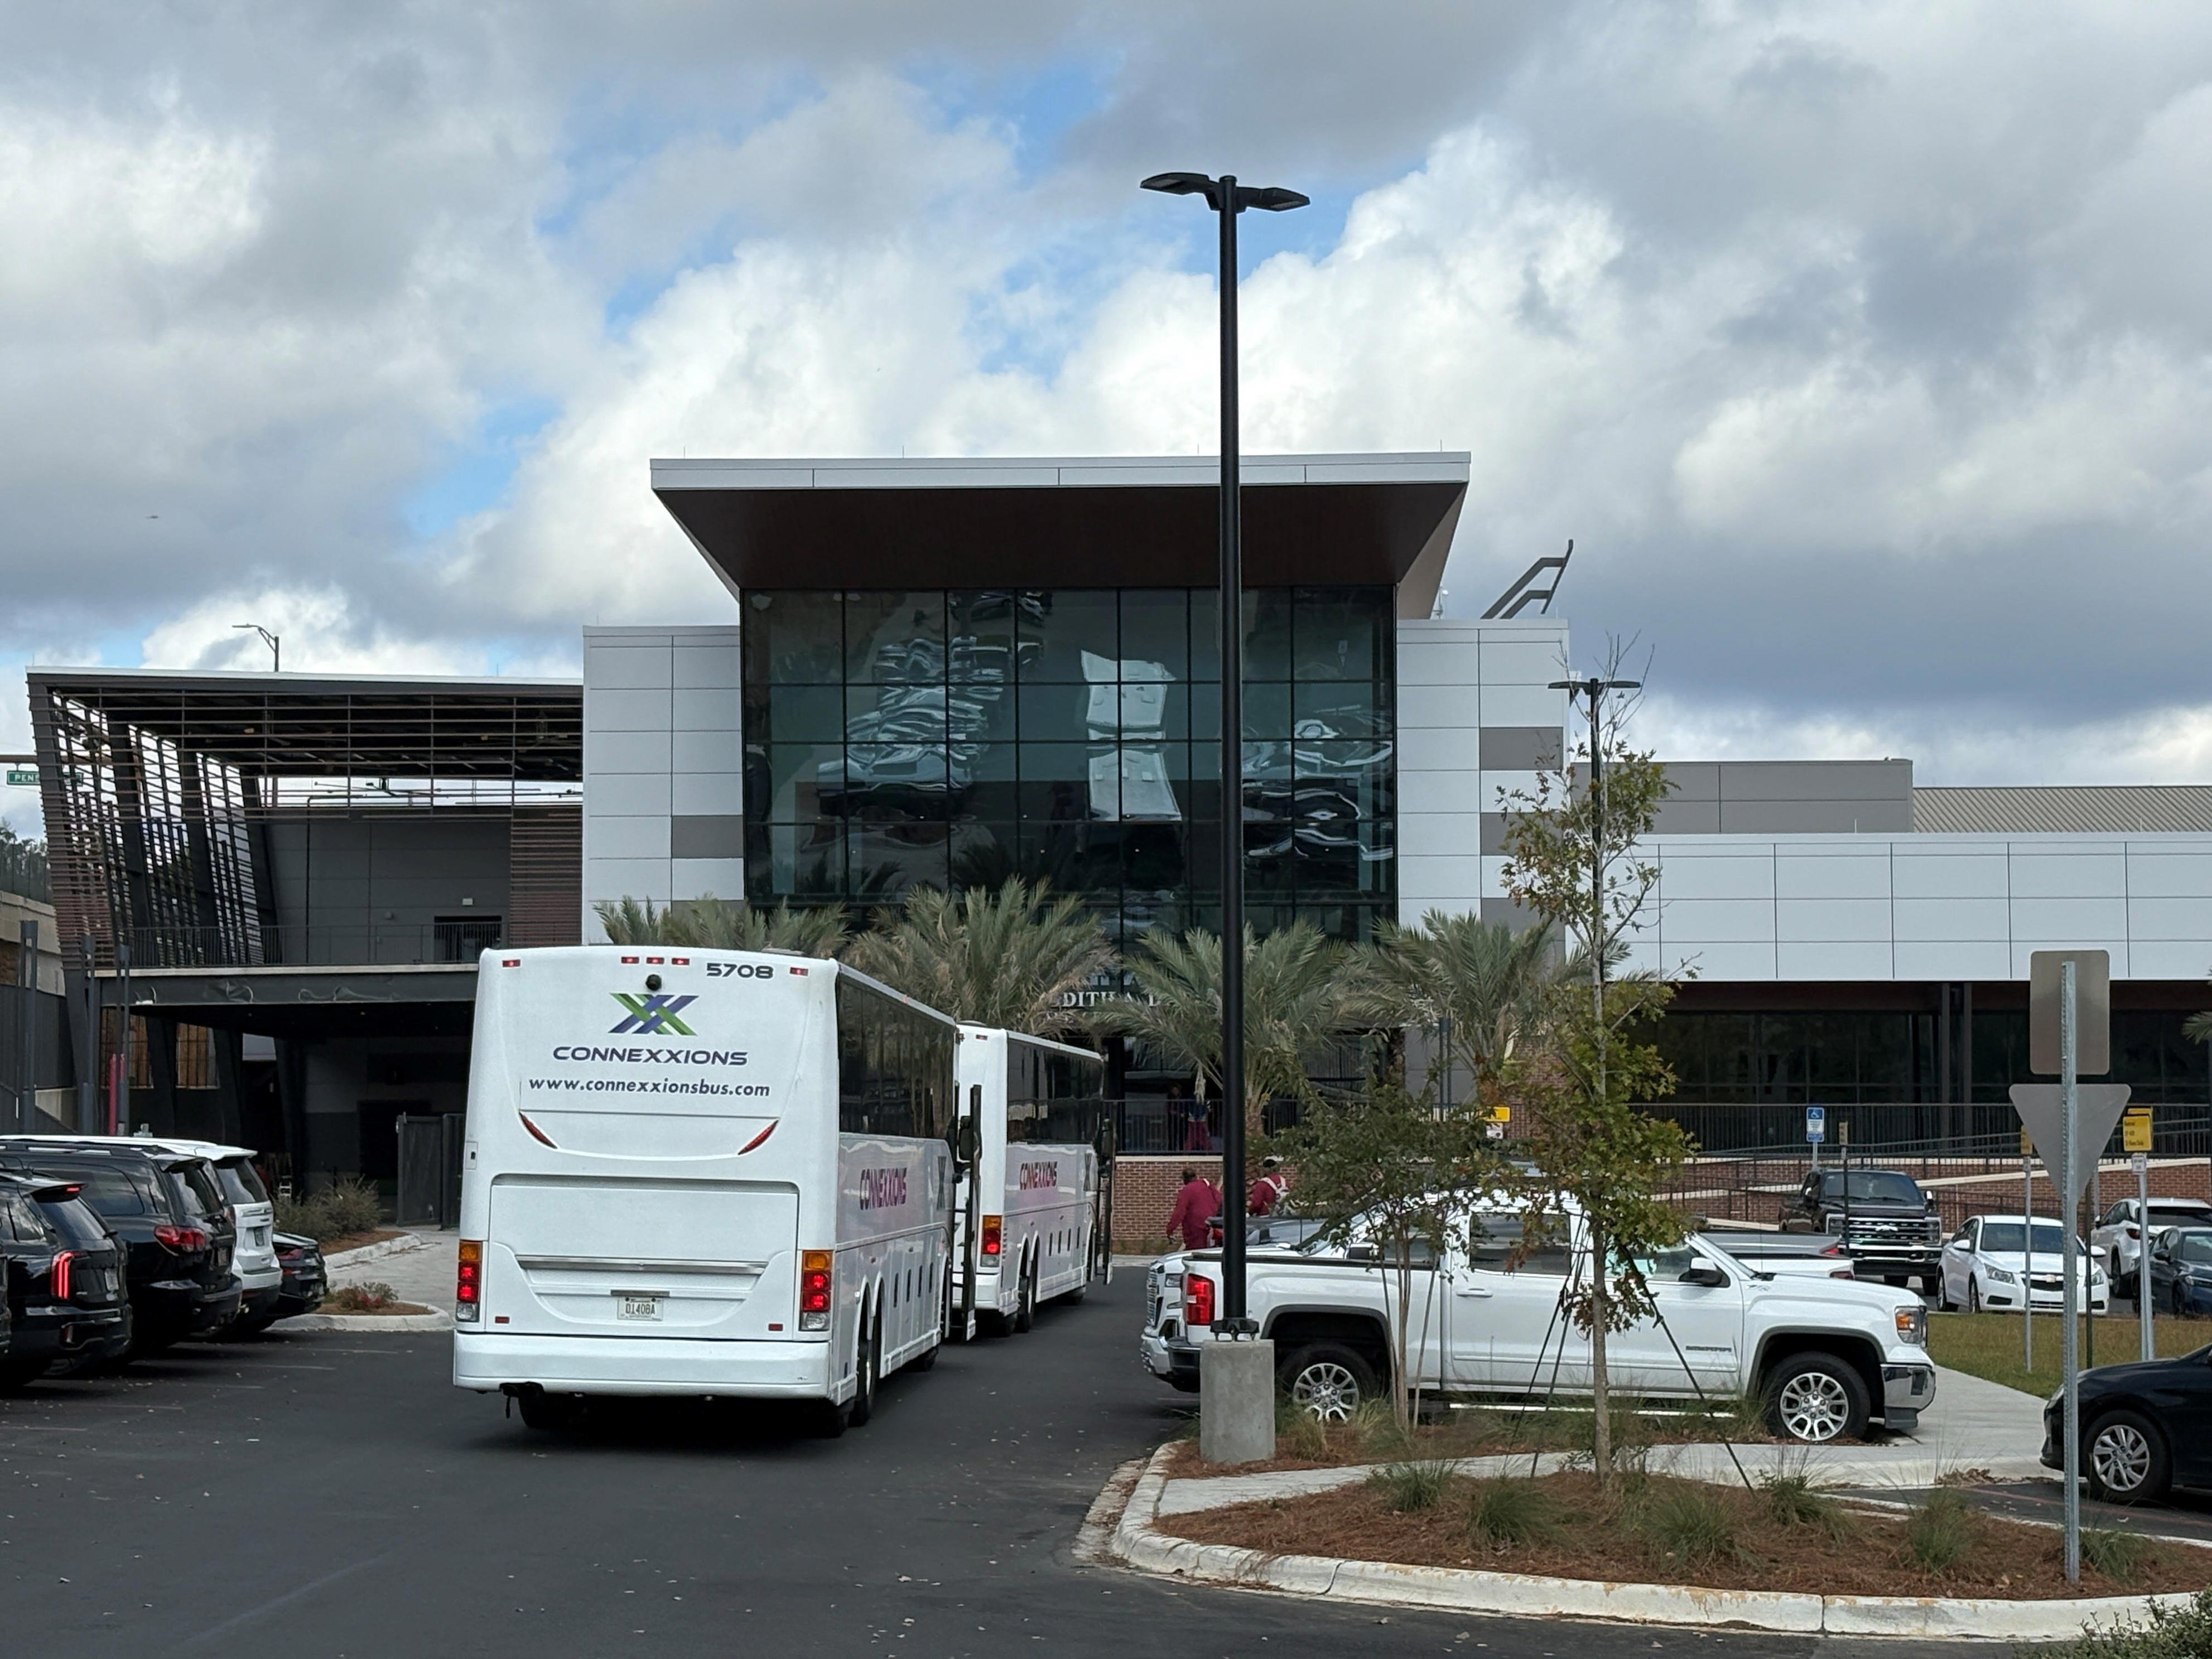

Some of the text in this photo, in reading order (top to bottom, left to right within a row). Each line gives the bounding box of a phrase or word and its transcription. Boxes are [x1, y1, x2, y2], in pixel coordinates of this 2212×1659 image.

[706, 962, 774, 979] 5708
[553, 1046, 748, 1065] CONNEXXIONS
[528, 1077, 770, 1097] www.connexxionsbus.com
